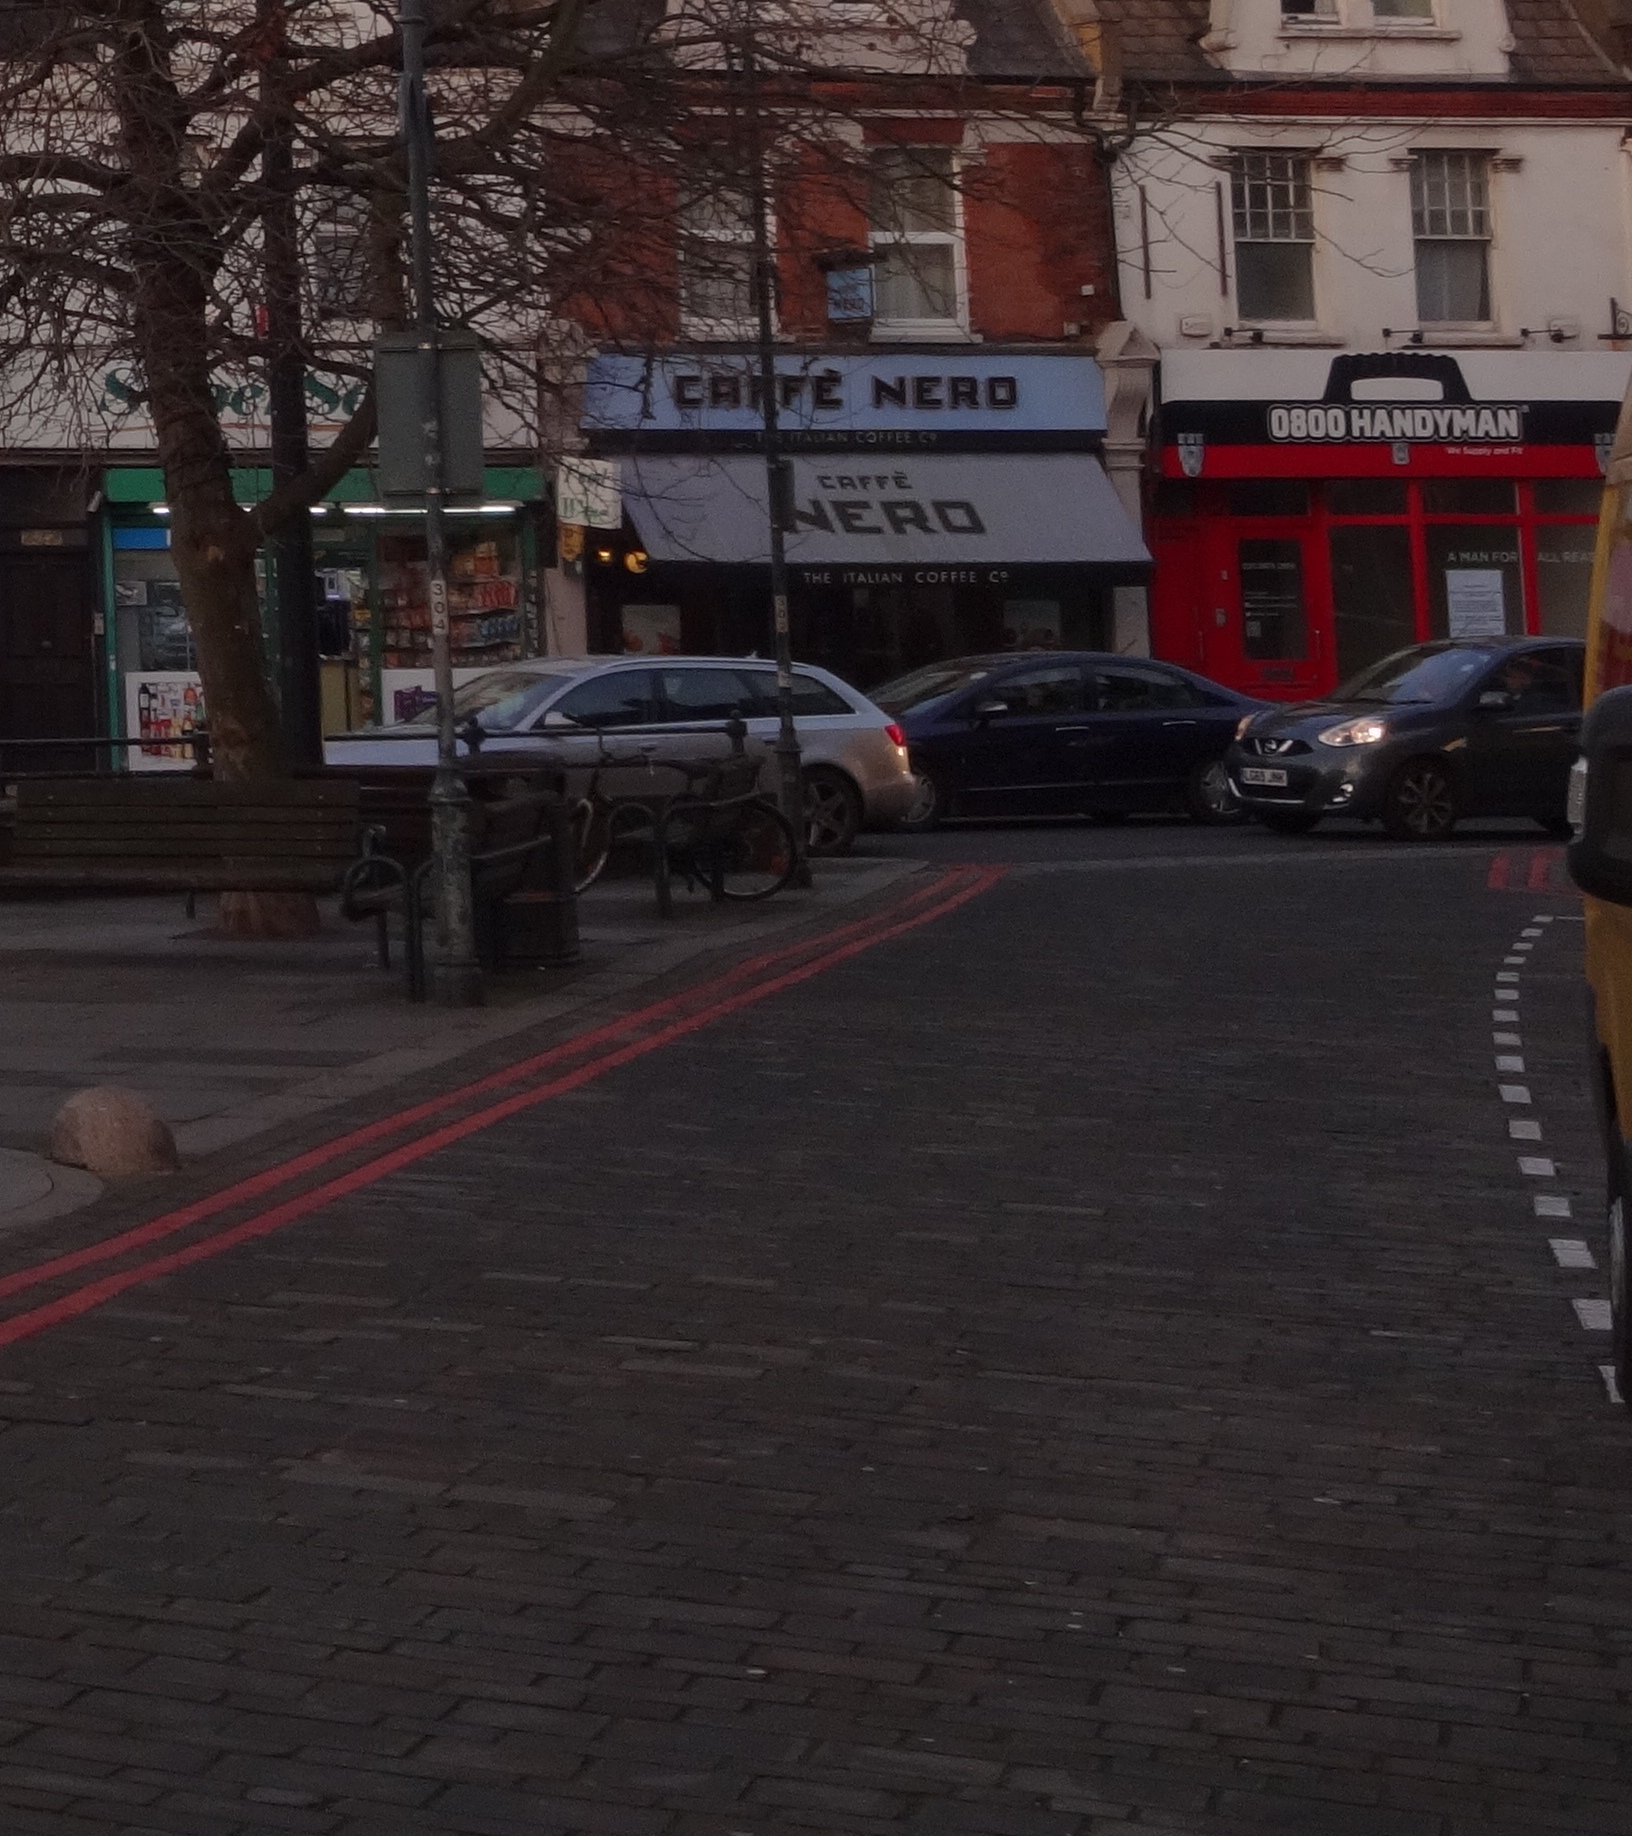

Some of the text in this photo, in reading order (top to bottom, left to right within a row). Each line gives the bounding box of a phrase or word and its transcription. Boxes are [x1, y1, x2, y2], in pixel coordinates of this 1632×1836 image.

[872, 375, 1016, 409] NERO
[1270, 407, 1521, 440] 0800 HANDYMAN
[855, 432, 912, 444] COFFEE
[784, 499, 986, 534] NERO
[1447, 552, 1457, 562] A
[1459, 552, 1489, 562] MAN
[1492, 552, 1518, 562] FOR
[1537, 552, 1560, 563] ALL
[804, 572, 832, 584] THE
[843, 572, 903, 583] ITALIAN
[914, 571, 977, 583] COFFEE
